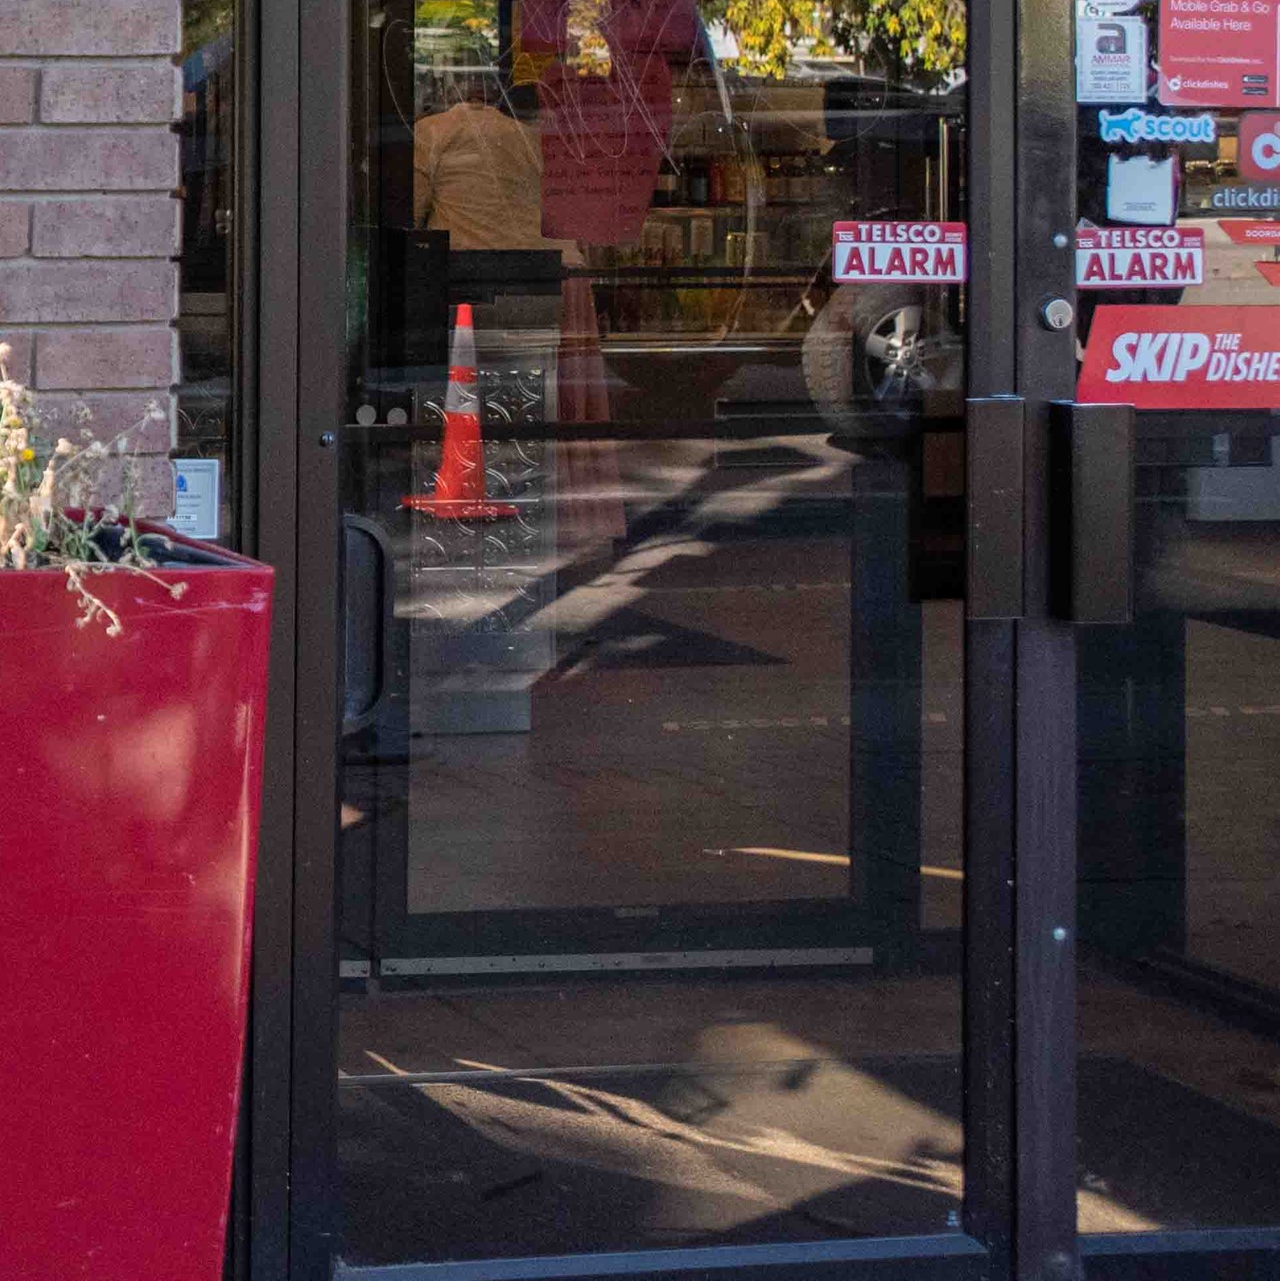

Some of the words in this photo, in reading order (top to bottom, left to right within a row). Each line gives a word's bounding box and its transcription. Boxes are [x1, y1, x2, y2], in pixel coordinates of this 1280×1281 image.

[1170, 0, 1208, 11] Mobile
[1210, 0, 1238, 13] Grab
[1240, 1, 1250, 13] &
[1252, 1, 1270, 14] Go
[1170, 17, 1220, 30] Available
[1223, 19, 1252, 31] Here
[1144, 119, 1211, 138] scout
[857, 224, 941, 243] TELSCO
[1097, 230, 1180, 248] TELSCO
[841, 246, 956, 276] ALARM
[1083, 252, 1196, 281] ALARM
[1105, 332, 1210, 383] SKIP
[1214, 333, 1242, 351] THE
